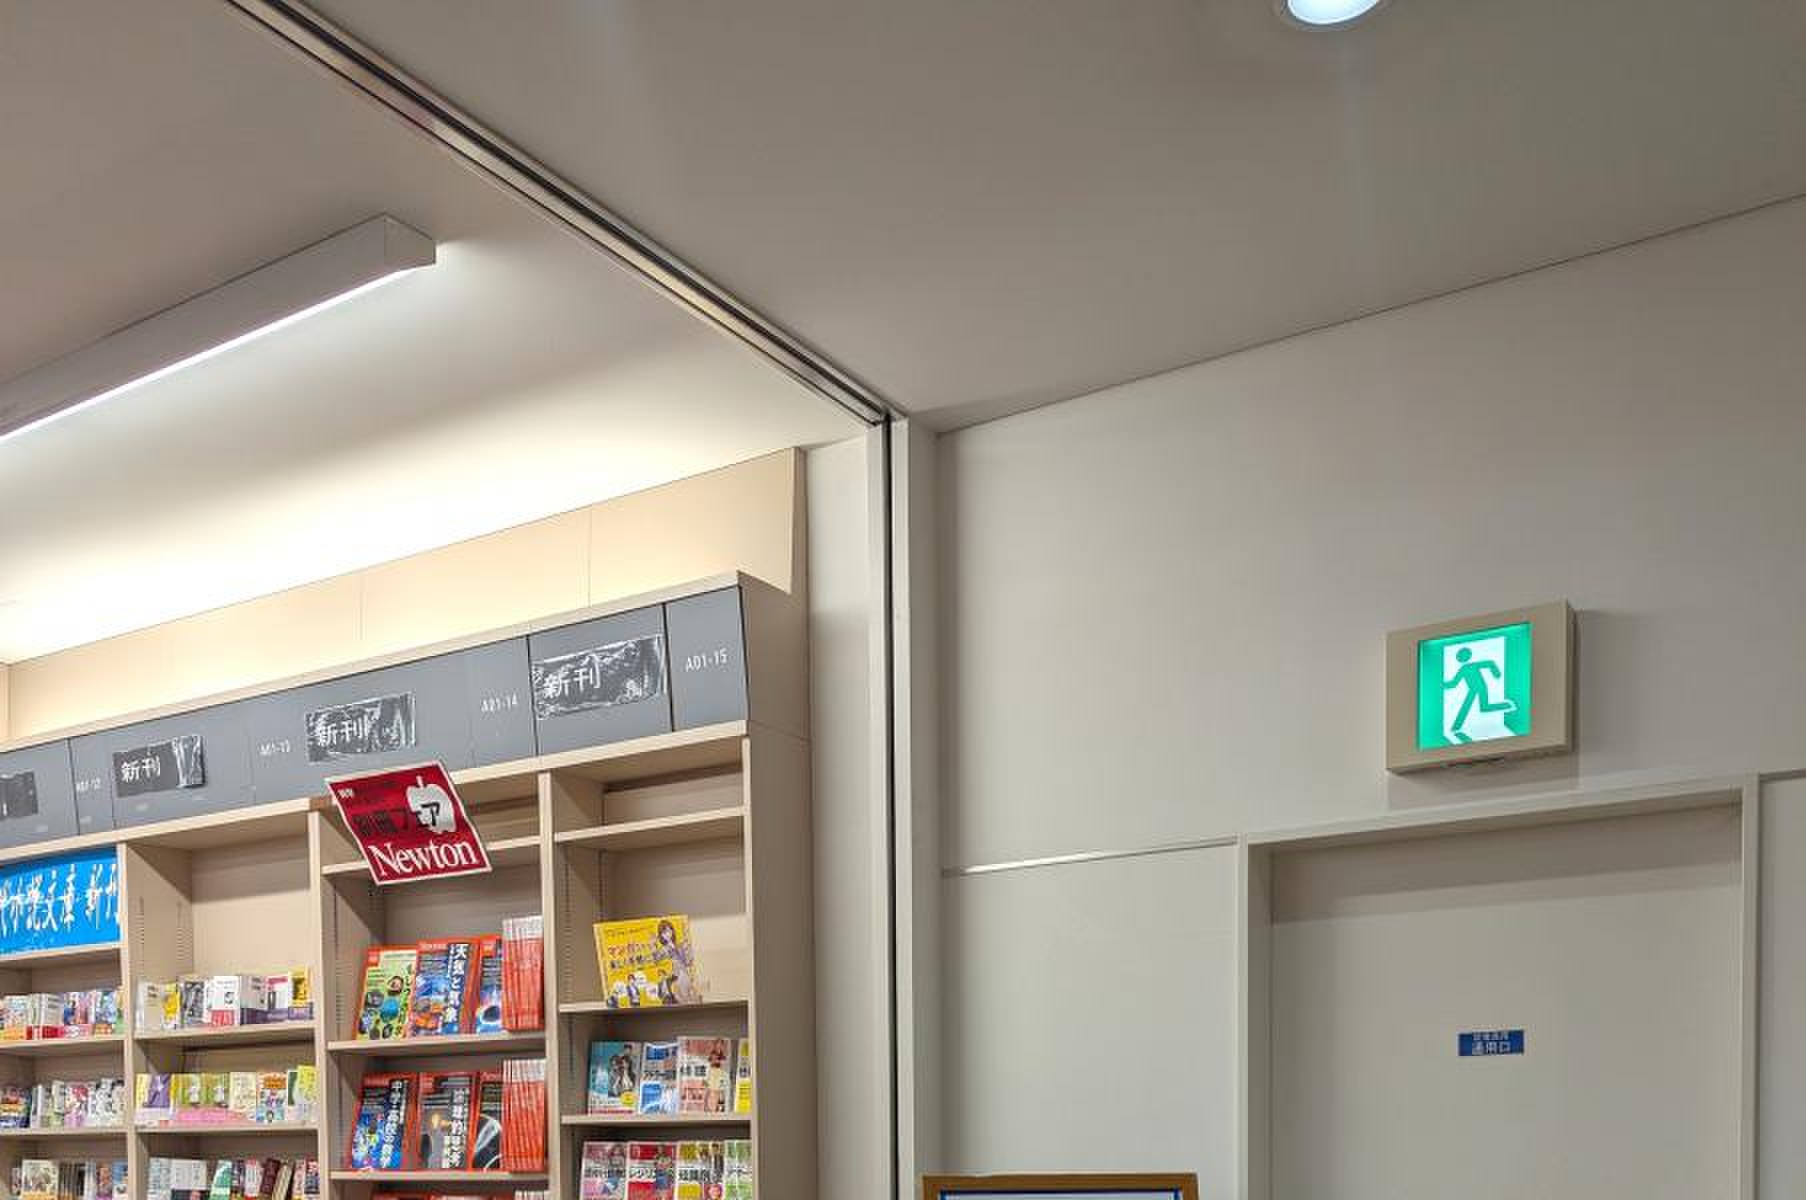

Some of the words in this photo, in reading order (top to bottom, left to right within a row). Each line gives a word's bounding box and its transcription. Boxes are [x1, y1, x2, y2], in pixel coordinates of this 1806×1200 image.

[686, 648, 728, 672] A01-15
[543, 661, 600, 699] 新刊
[315, 713, 370, 747] 新刊
[121, 755, 161, 783] 新刊
[367, 840, 479, 877] Newton
